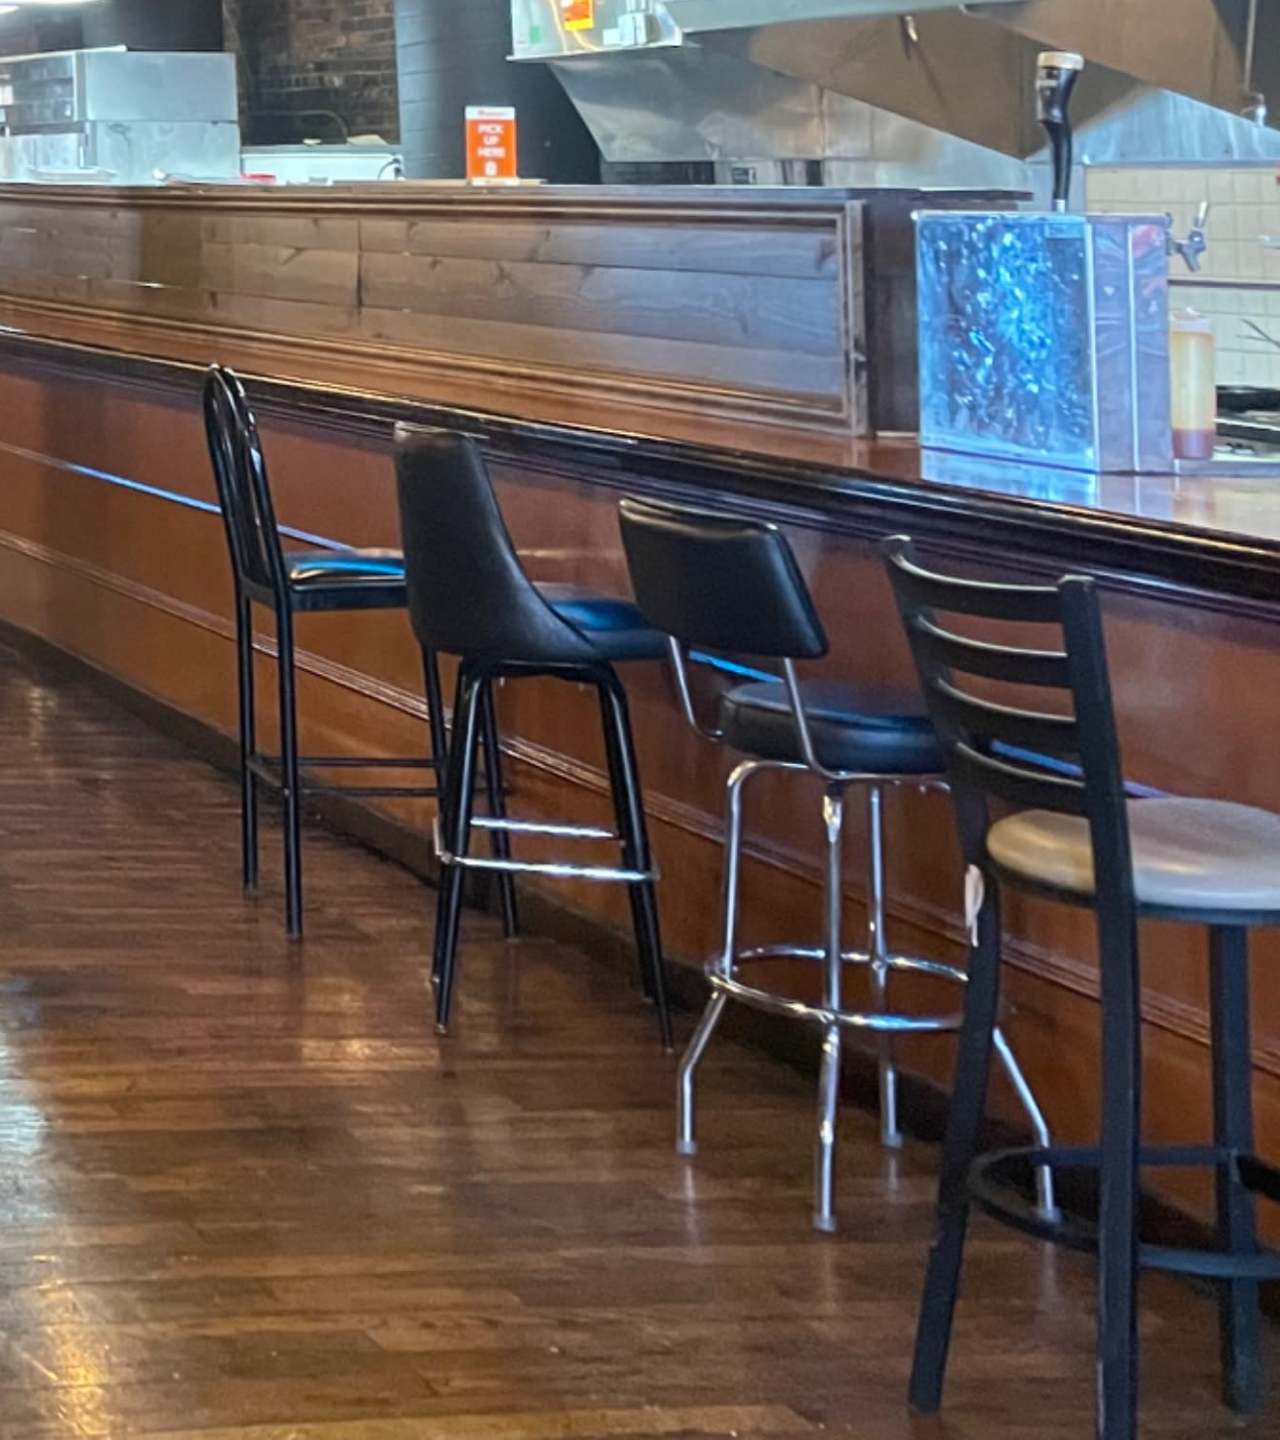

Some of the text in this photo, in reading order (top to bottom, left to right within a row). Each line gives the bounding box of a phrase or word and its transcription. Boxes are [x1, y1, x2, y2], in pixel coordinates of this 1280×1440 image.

[477, 123, 504, 135] PICK
[483, 135, 500, 146] UP
[477, 147, 506, 158] HERE
